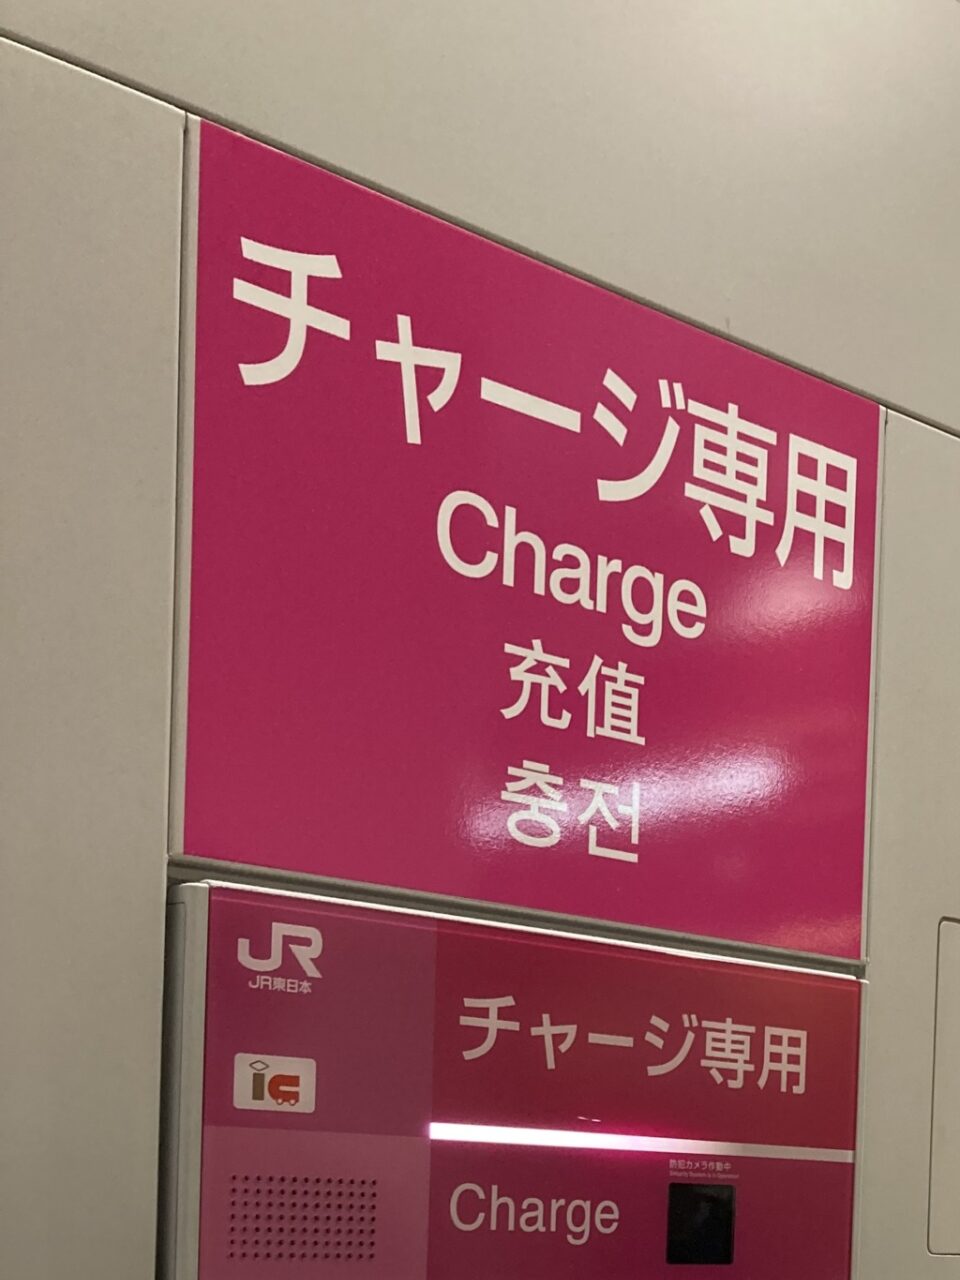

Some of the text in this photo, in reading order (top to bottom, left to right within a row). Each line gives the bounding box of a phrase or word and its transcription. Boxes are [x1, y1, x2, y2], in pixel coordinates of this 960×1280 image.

[232, 236, 858, 590] チャージ専用
[437, 490, 707, 648] Charge
[500, 638, 646, 746] 充值
[500, 760, 641, 864] 충전
[237, 921, 323, 978] JR
[248, 975, 312, 995] JR東日本
[459, 995, 808, 1095] チャージ専用
[449, 1182, 620, 1246] Charge
